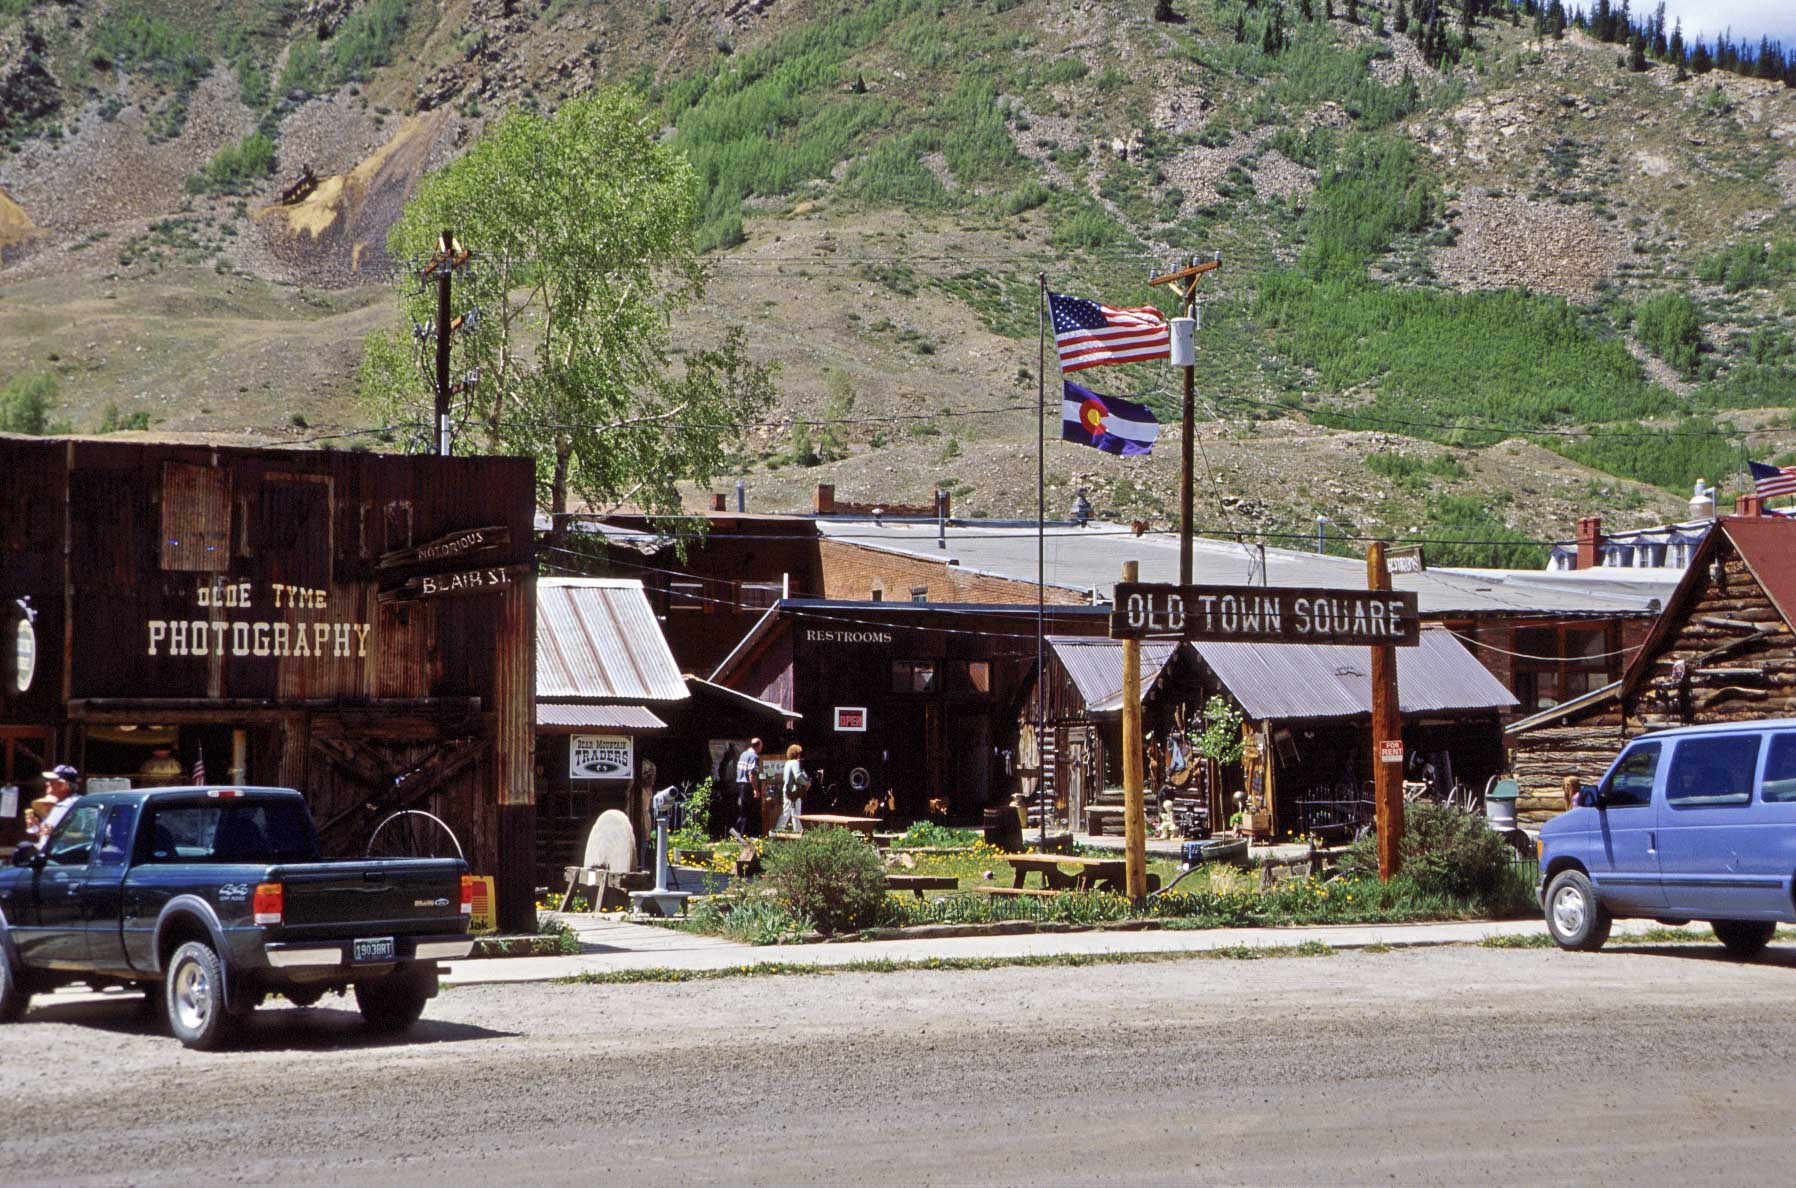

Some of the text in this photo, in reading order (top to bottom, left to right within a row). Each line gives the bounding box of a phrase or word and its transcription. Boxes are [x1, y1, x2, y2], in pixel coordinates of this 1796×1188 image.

[418, 532, 484, 560] NOTORIOUS
[422, 571, 482, 594] BLAIR
[197, 583, 327, 609] OLDE TYME
[1127, 593, 1405, 636] OLD TOWN SQUARE
[148, 620, 371, 657] PHOTOGRAPHY
[806, 630, 893, 643] RESTROOMS
[575, 750, 628, 766] TRADERS
[1381, 748, 1403, 756] RENT
